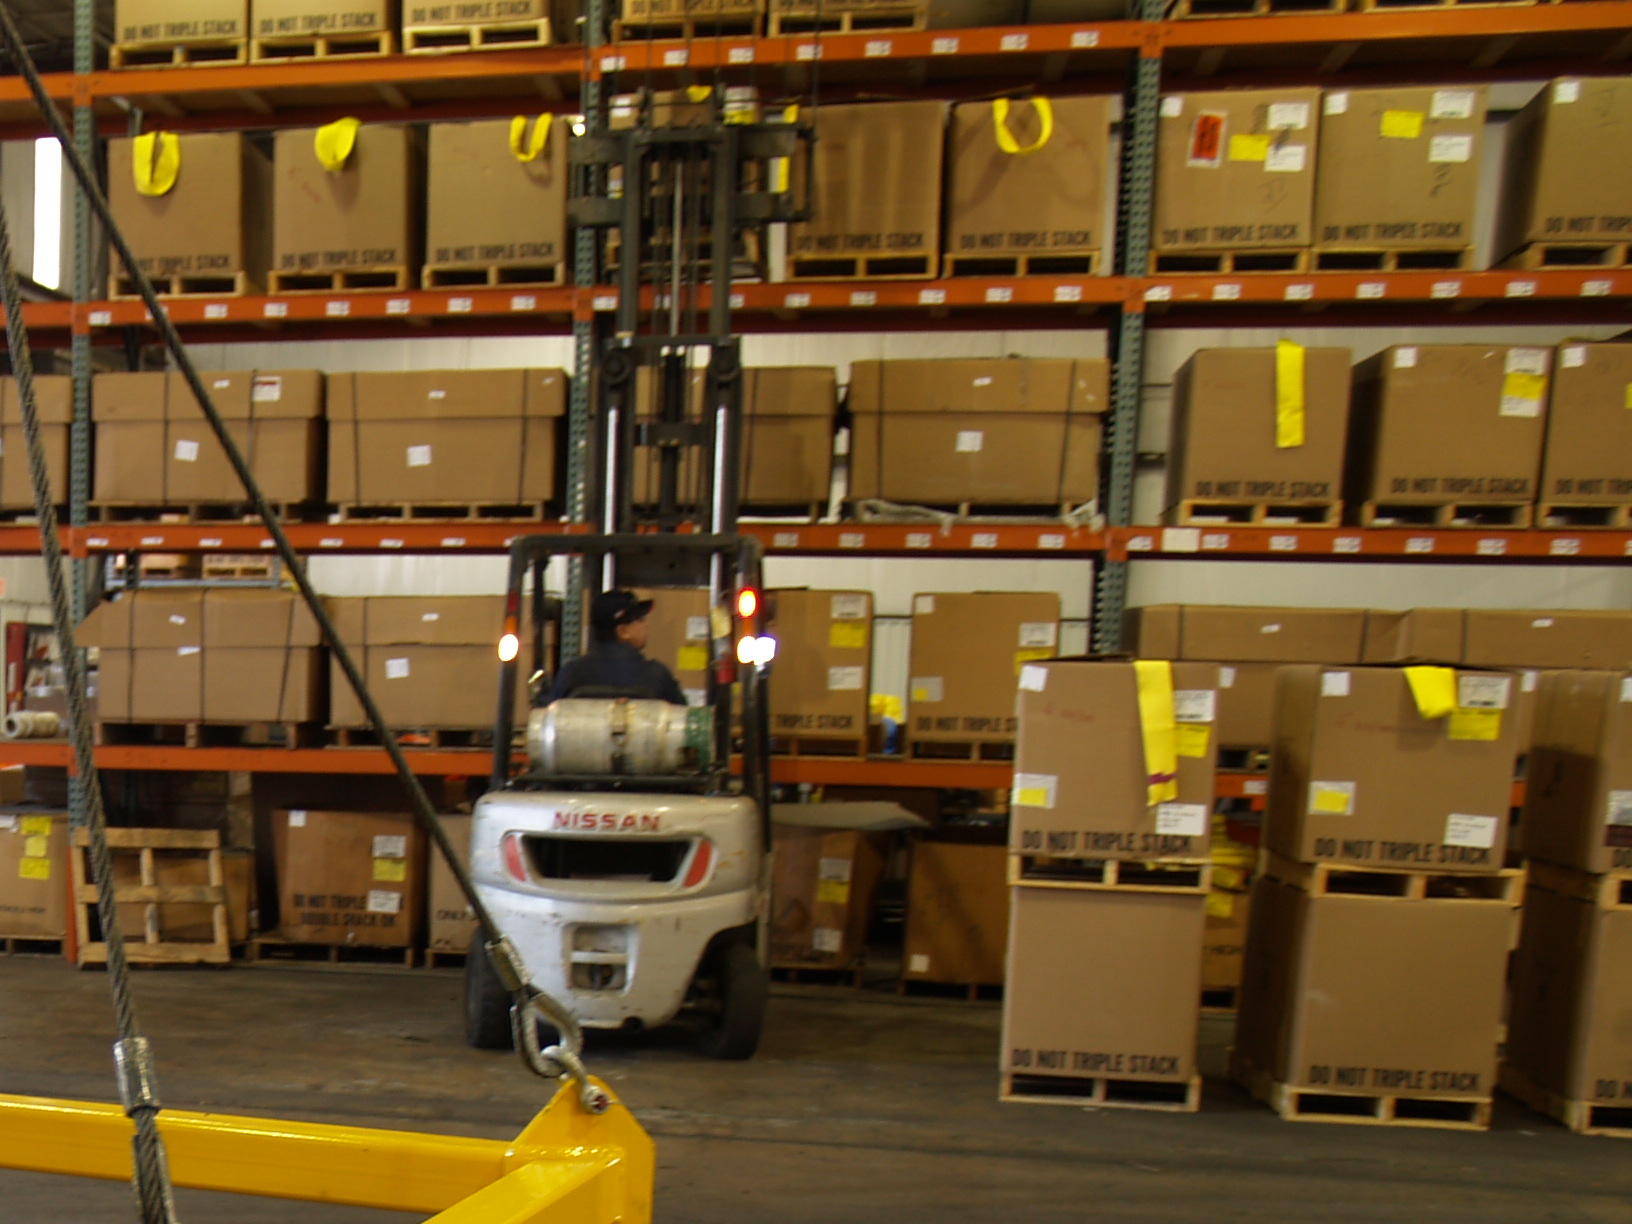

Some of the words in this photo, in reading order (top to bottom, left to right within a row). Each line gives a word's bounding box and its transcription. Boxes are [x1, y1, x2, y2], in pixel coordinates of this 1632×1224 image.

[553, 811, 661, 831] NISSAN
[1022, 830, 1041, 850] DO
[1048, 831, 1078, 850] NOT
[1084, 831, 1136, 852] TRIPLE
[1141, 833, 1192, 854] STACK
[1314, 838, 1337, 858] DO
[1342, 839, 1374, 859] NOT
[1379, 841, 1434, 862] TRIPLE
[1438, 844, 1490, 865] STACK
[1012, 1048, 1031, 1068] DO
[1037, 1050, 1067, 1069] NOT
[1073, 1051, 1125, 1072] TRIPLE
[1129, 1055, 1180, 1075] STACK
[1309, 1065, 1331, 1085] DO
[1336, 1066, 1367, 1087] NOT
[1372, 1068, 1425, 1090] TRIPLE
[1429, 1070, 1481, 1091] STACK
[1595, 1079, 1619, 1099] DO
